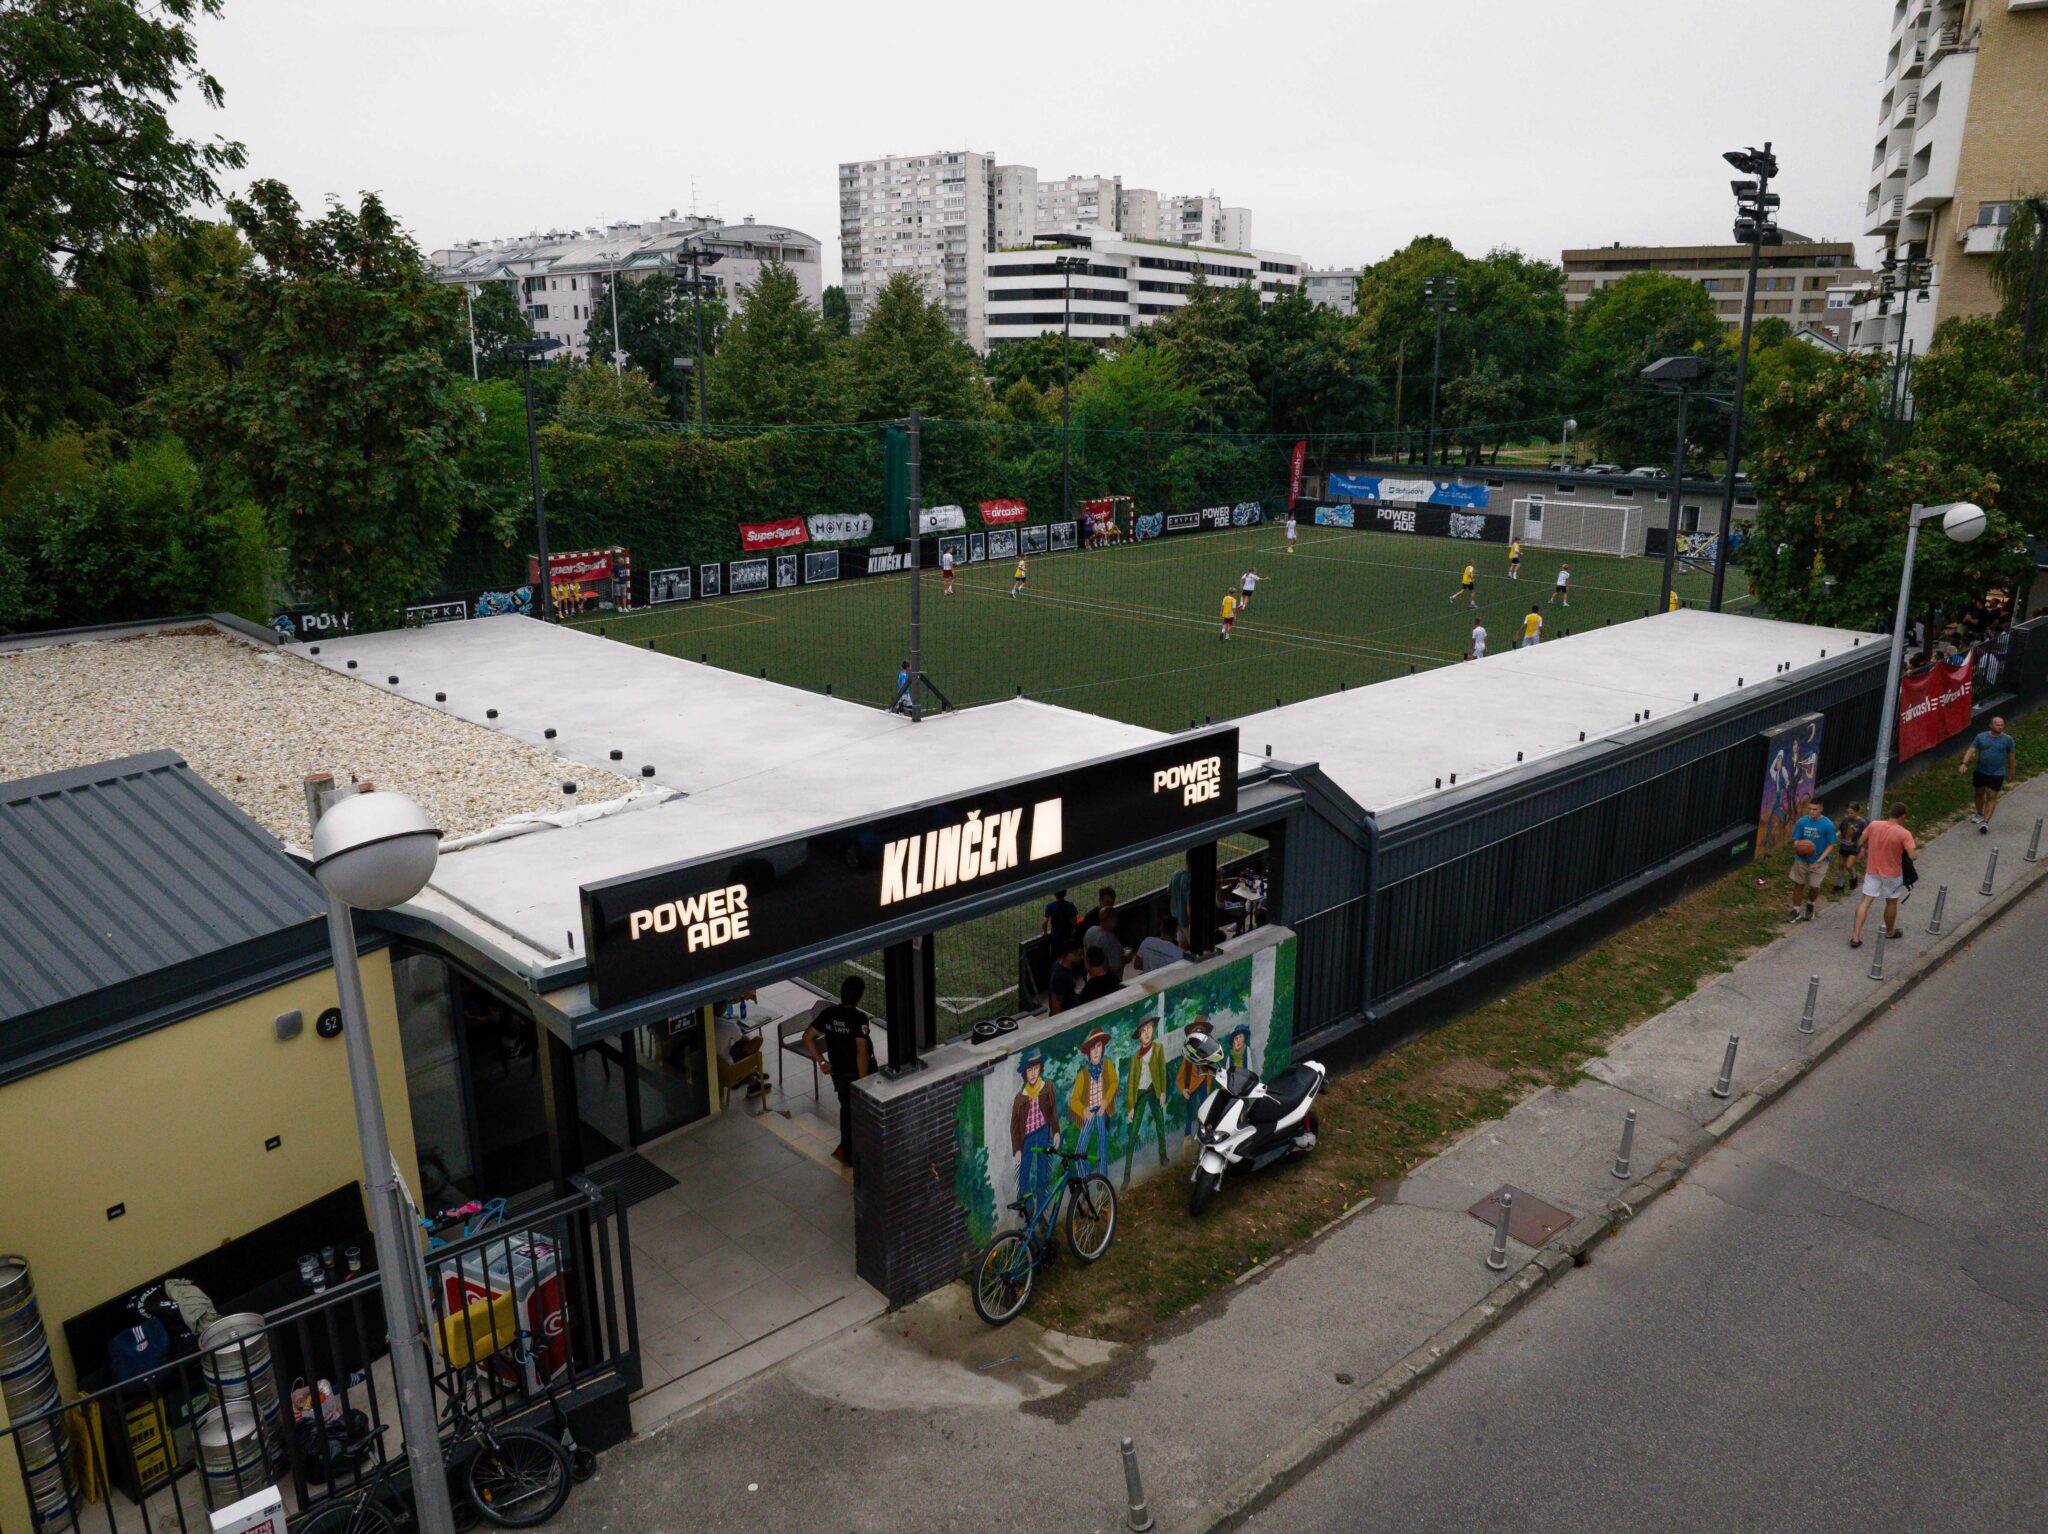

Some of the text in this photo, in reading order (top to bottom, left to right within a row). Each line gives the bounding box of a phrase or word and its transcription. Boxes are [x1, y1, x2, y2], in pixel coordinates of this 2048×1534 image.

[991, 507, 1020, 517] aircash
[1202, 506, 1230, 519] POWER
[1377, 508, 1416, 522] POWER
[816, 520, 869, 534] MOVEYE
[1214, 516, 1230, 527] ADE
[1393, 520, 1416, 532] ADE
[747, 526, 801, 542] SuperSport
[1905, 696, 1931, 721] aircash
[1154, 756, 1221, 794] POWER
[1184, 777, 1221, 806] ADE
[880, 808, 1023, 906] KLINČEK
[630, 884, 749, 941] POWER
[687, 910, 750, 953] ADE
